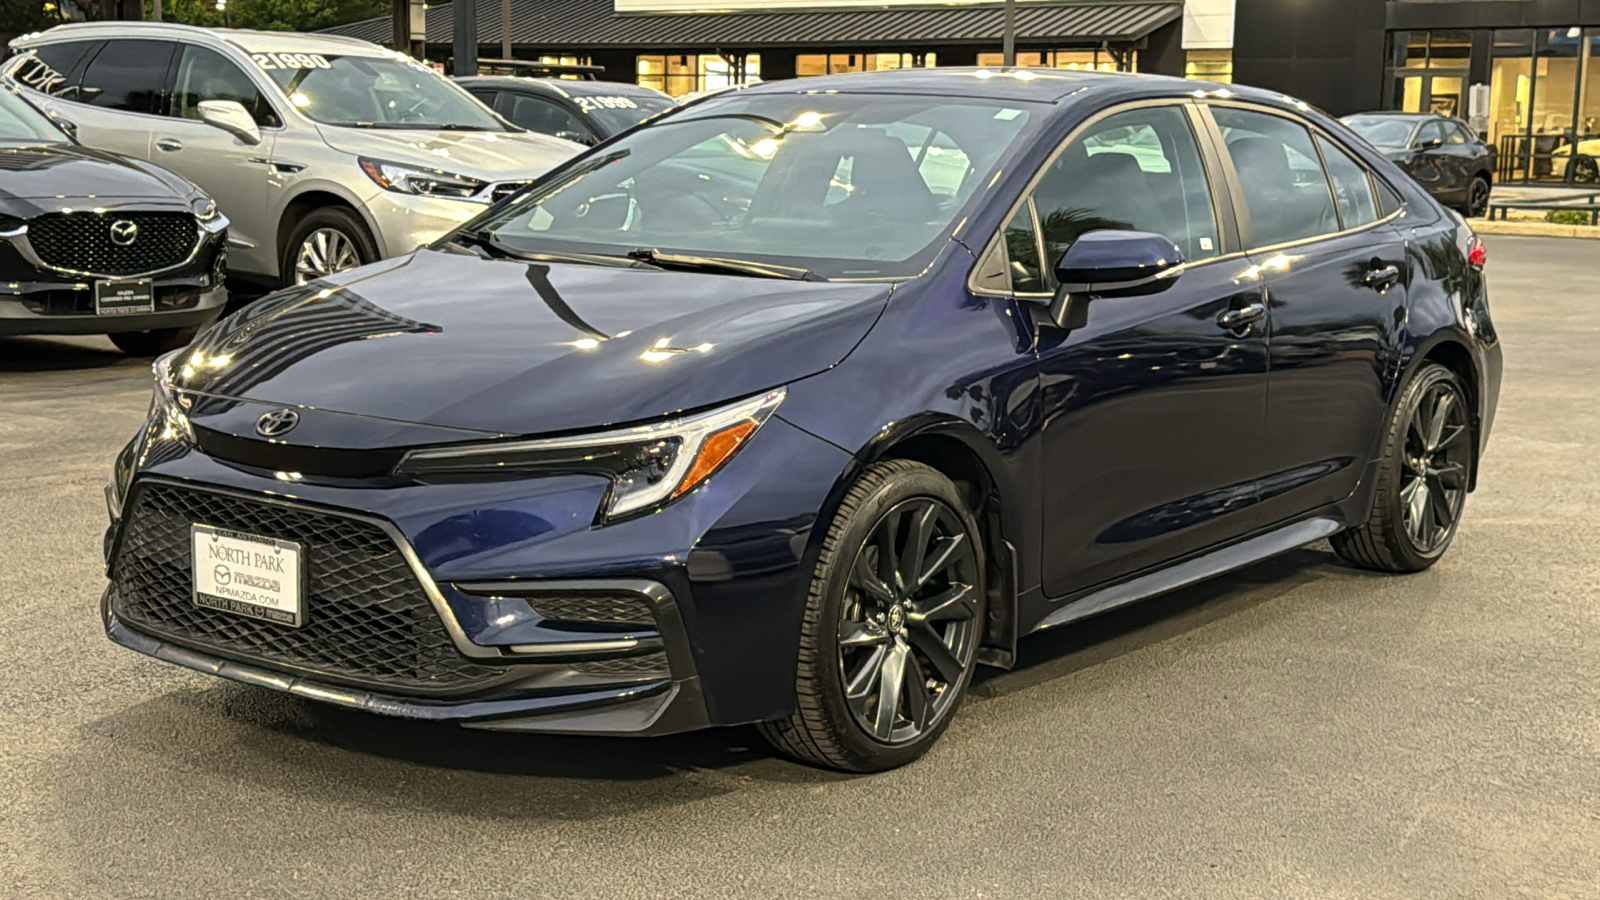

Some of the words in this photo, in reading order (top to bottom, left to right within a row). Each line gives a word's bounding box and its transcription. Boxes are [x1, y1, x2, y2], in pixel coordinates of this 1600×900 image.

[252, 53, 331, 69] 21990
[208, 543, 250, 567] NORTH
[254, 552, 285, 574] PARK
[199, 594, 229, 609] NORTH
[230, 601, 254, 616] PARK
[215, 585, 279, 607] NPMAZDA.COM
